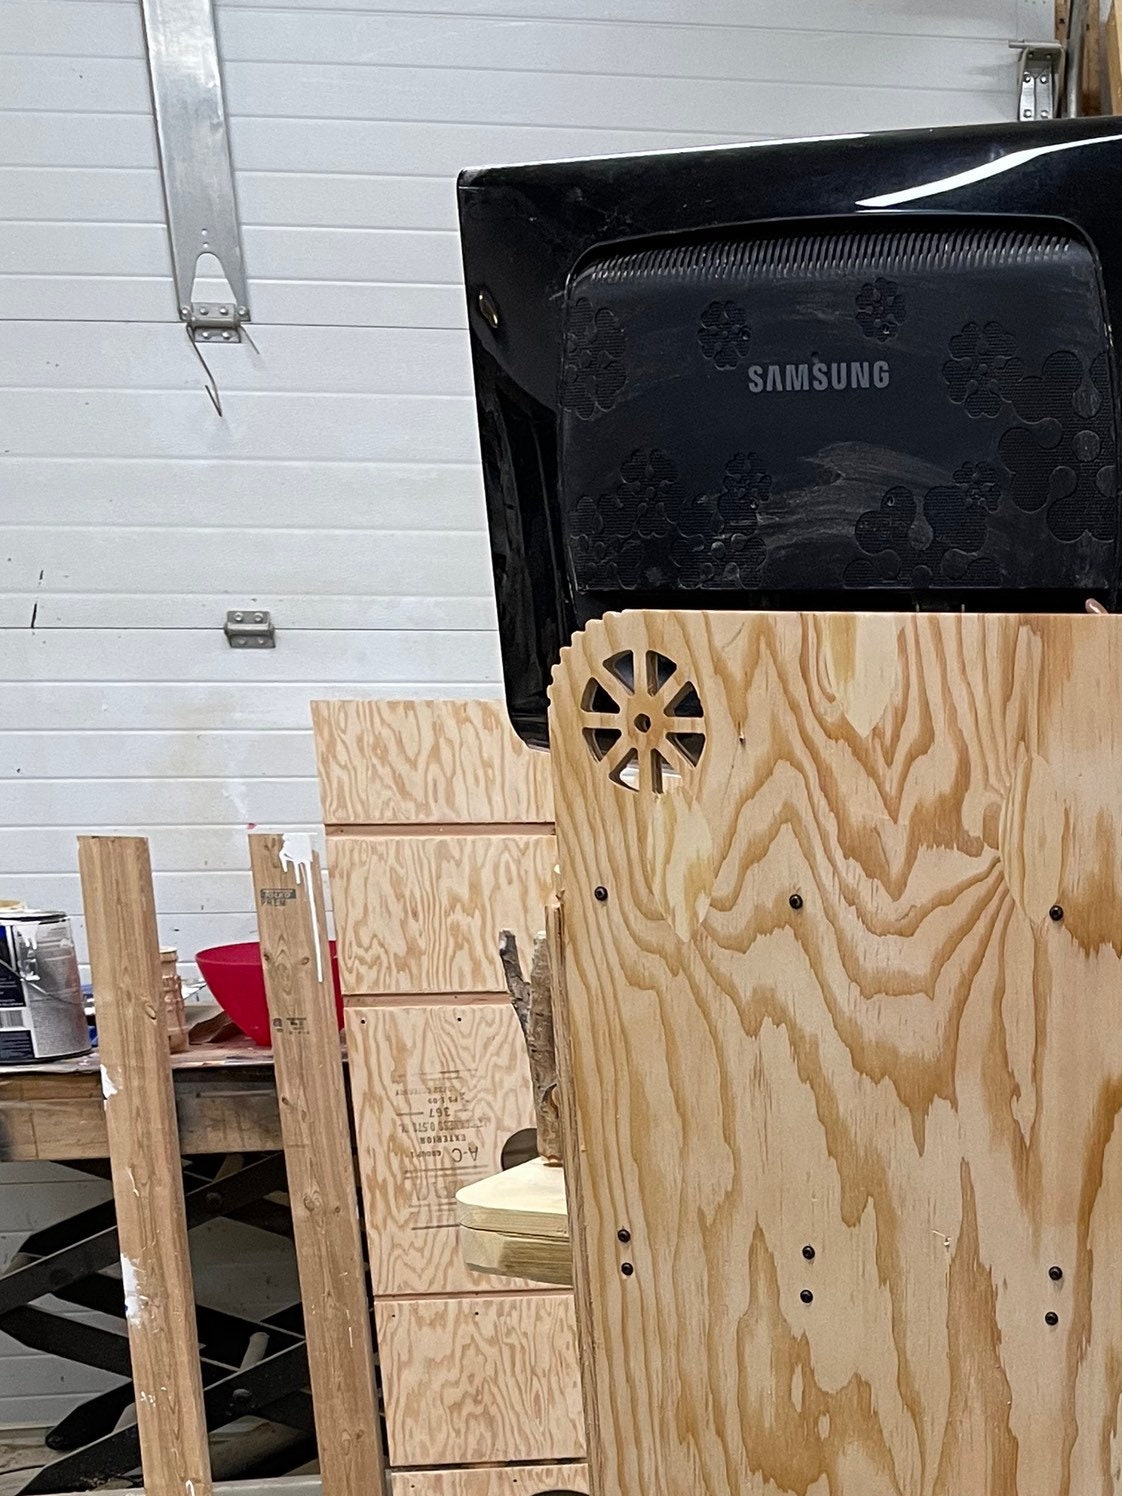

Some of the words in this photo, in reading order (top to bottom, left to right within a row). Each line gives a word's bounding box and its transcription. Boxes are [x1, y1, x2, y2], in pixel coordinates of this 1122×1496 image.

[748, 361, 890, 393] SAMSUNG
[428, 1106, 451, 1118] 367
[419, 1134, 466, 1144] EXTERIOR
